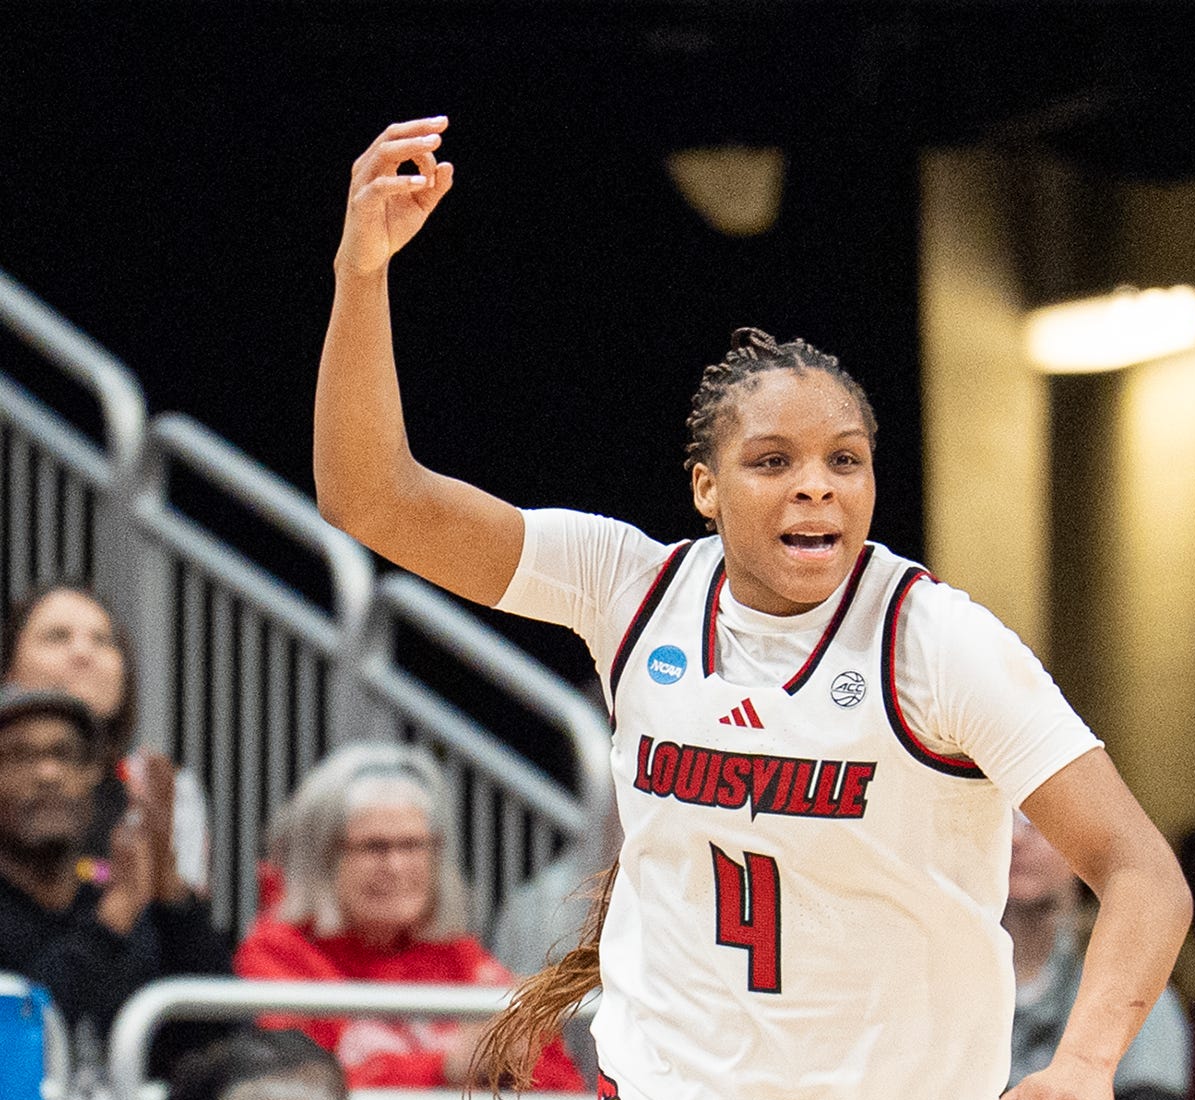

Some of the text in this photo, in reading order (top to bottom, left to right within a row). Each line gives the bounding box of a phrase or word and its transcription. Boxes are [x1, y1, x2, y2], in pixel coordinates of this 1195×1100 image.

[649, 658, 683, 678] NCAA
[836, 682, 865, 693] ACC
[633, 734, 878, 823] LOUISVILLE
[709, 840, 782, 994] 4
